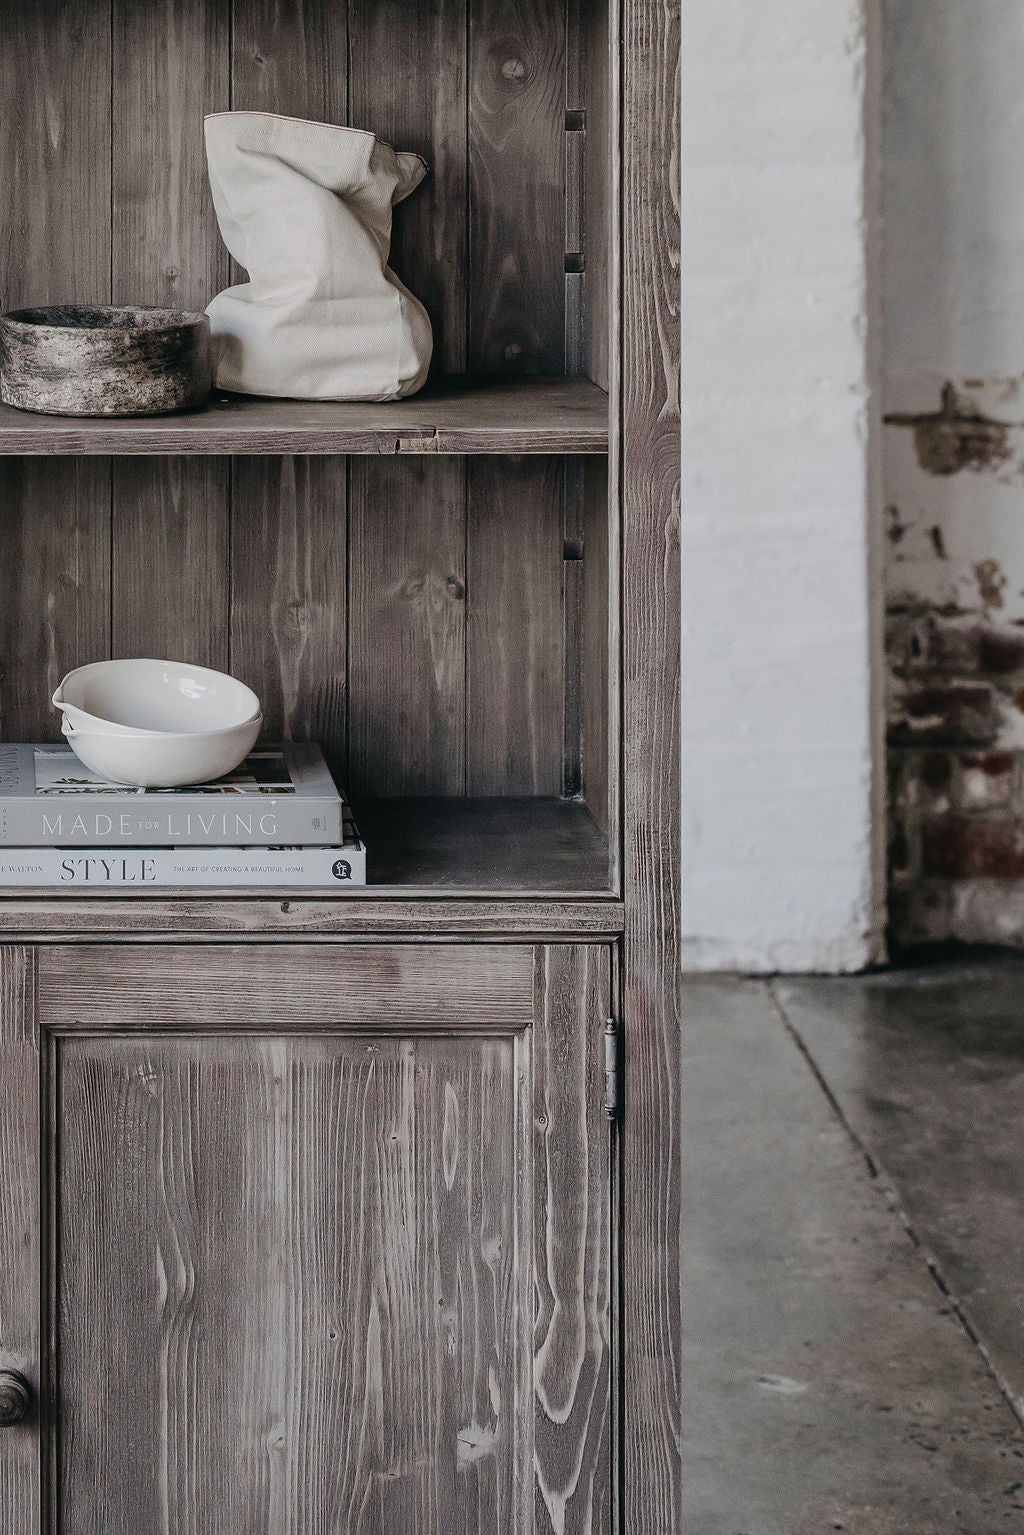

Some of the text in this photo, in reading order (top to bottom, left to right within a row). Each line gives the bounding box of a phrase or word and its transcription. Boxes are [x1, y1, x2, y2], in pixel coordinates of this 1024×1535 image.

[42, 814, 276, 835] MADE FOR LIVING
[8, 865, 43, 873] WALTON
[60, 858, 157, 881] STYLE
